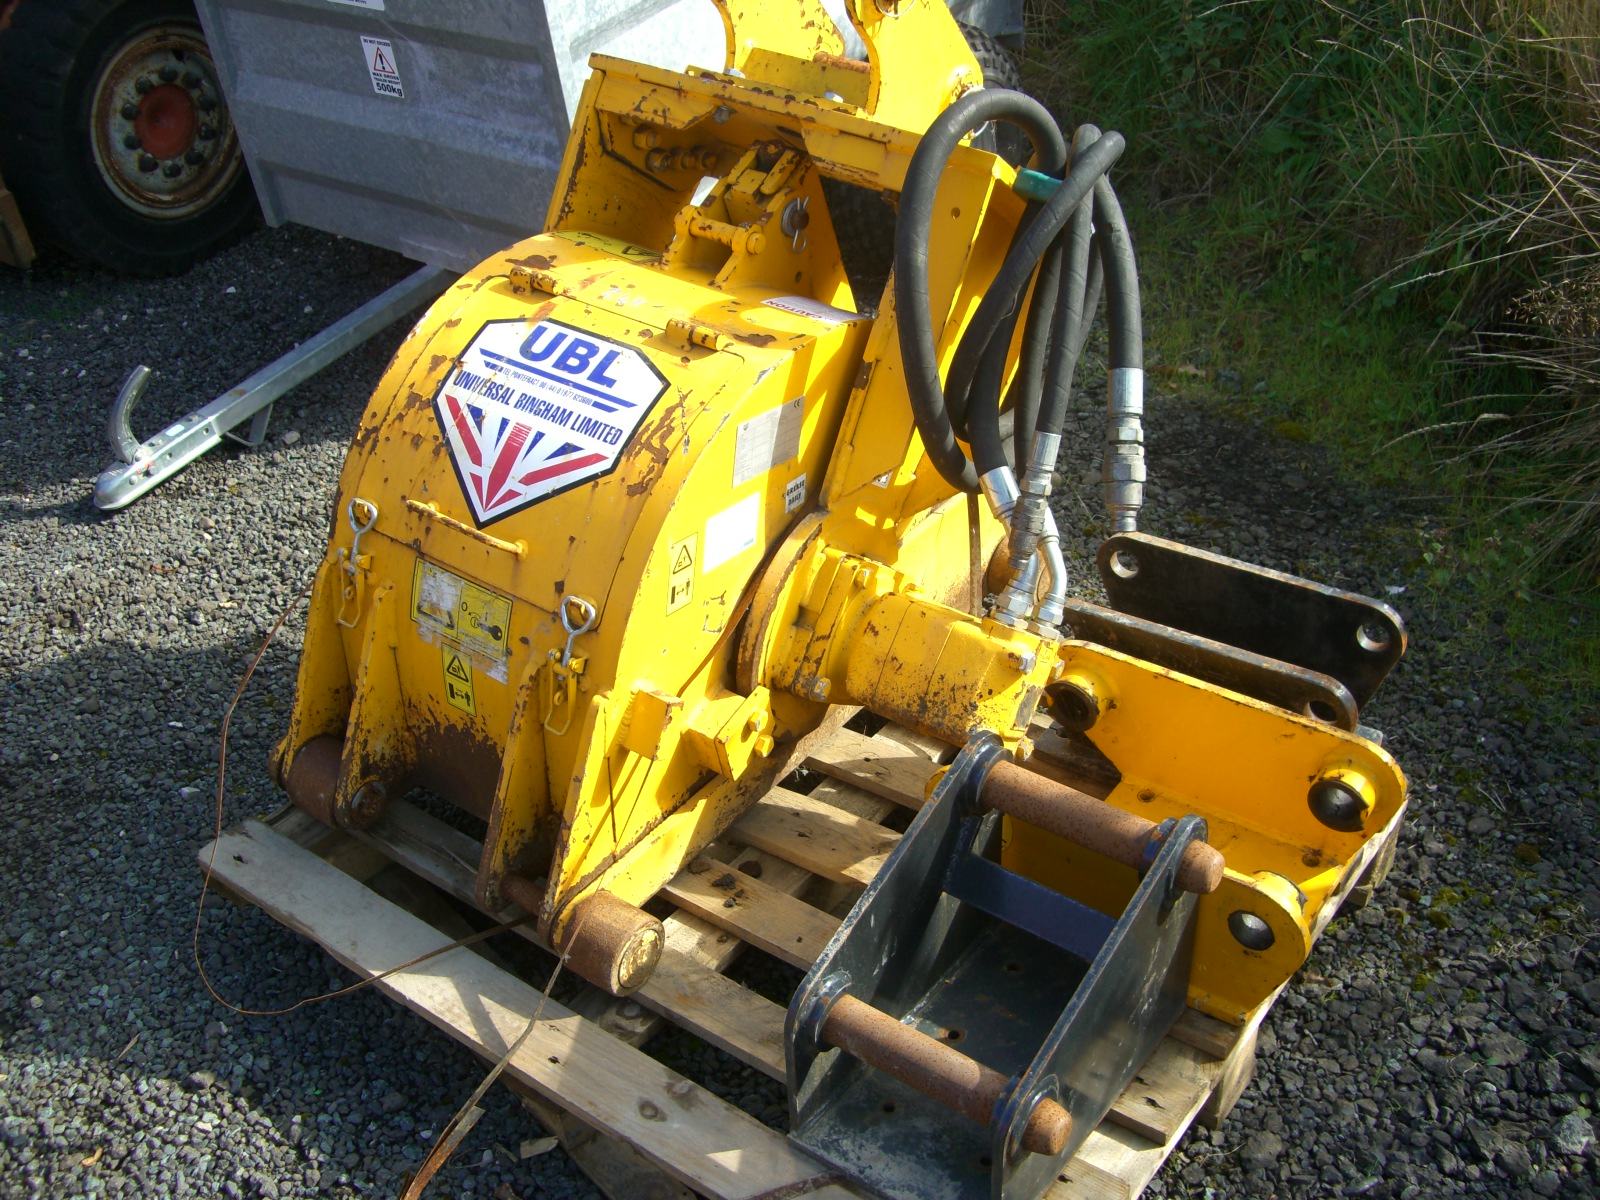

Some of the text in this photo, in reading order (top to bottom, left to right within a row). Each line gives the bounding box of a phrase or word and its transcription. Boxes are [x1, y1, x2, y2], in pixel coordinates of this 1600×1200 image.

[376, 82, 402, 97] 500kg
[766, 301, 822, 319] CAUTION
[519, 325, 621, 388] UBL
[503, 367, 511, 376] TEL
[453, 370, 623, 446] UNIVERSAL BINGHAM LIMITED
[787, 480, 805, 496] GREASE
[788, 492, 801, 505] DAILY
